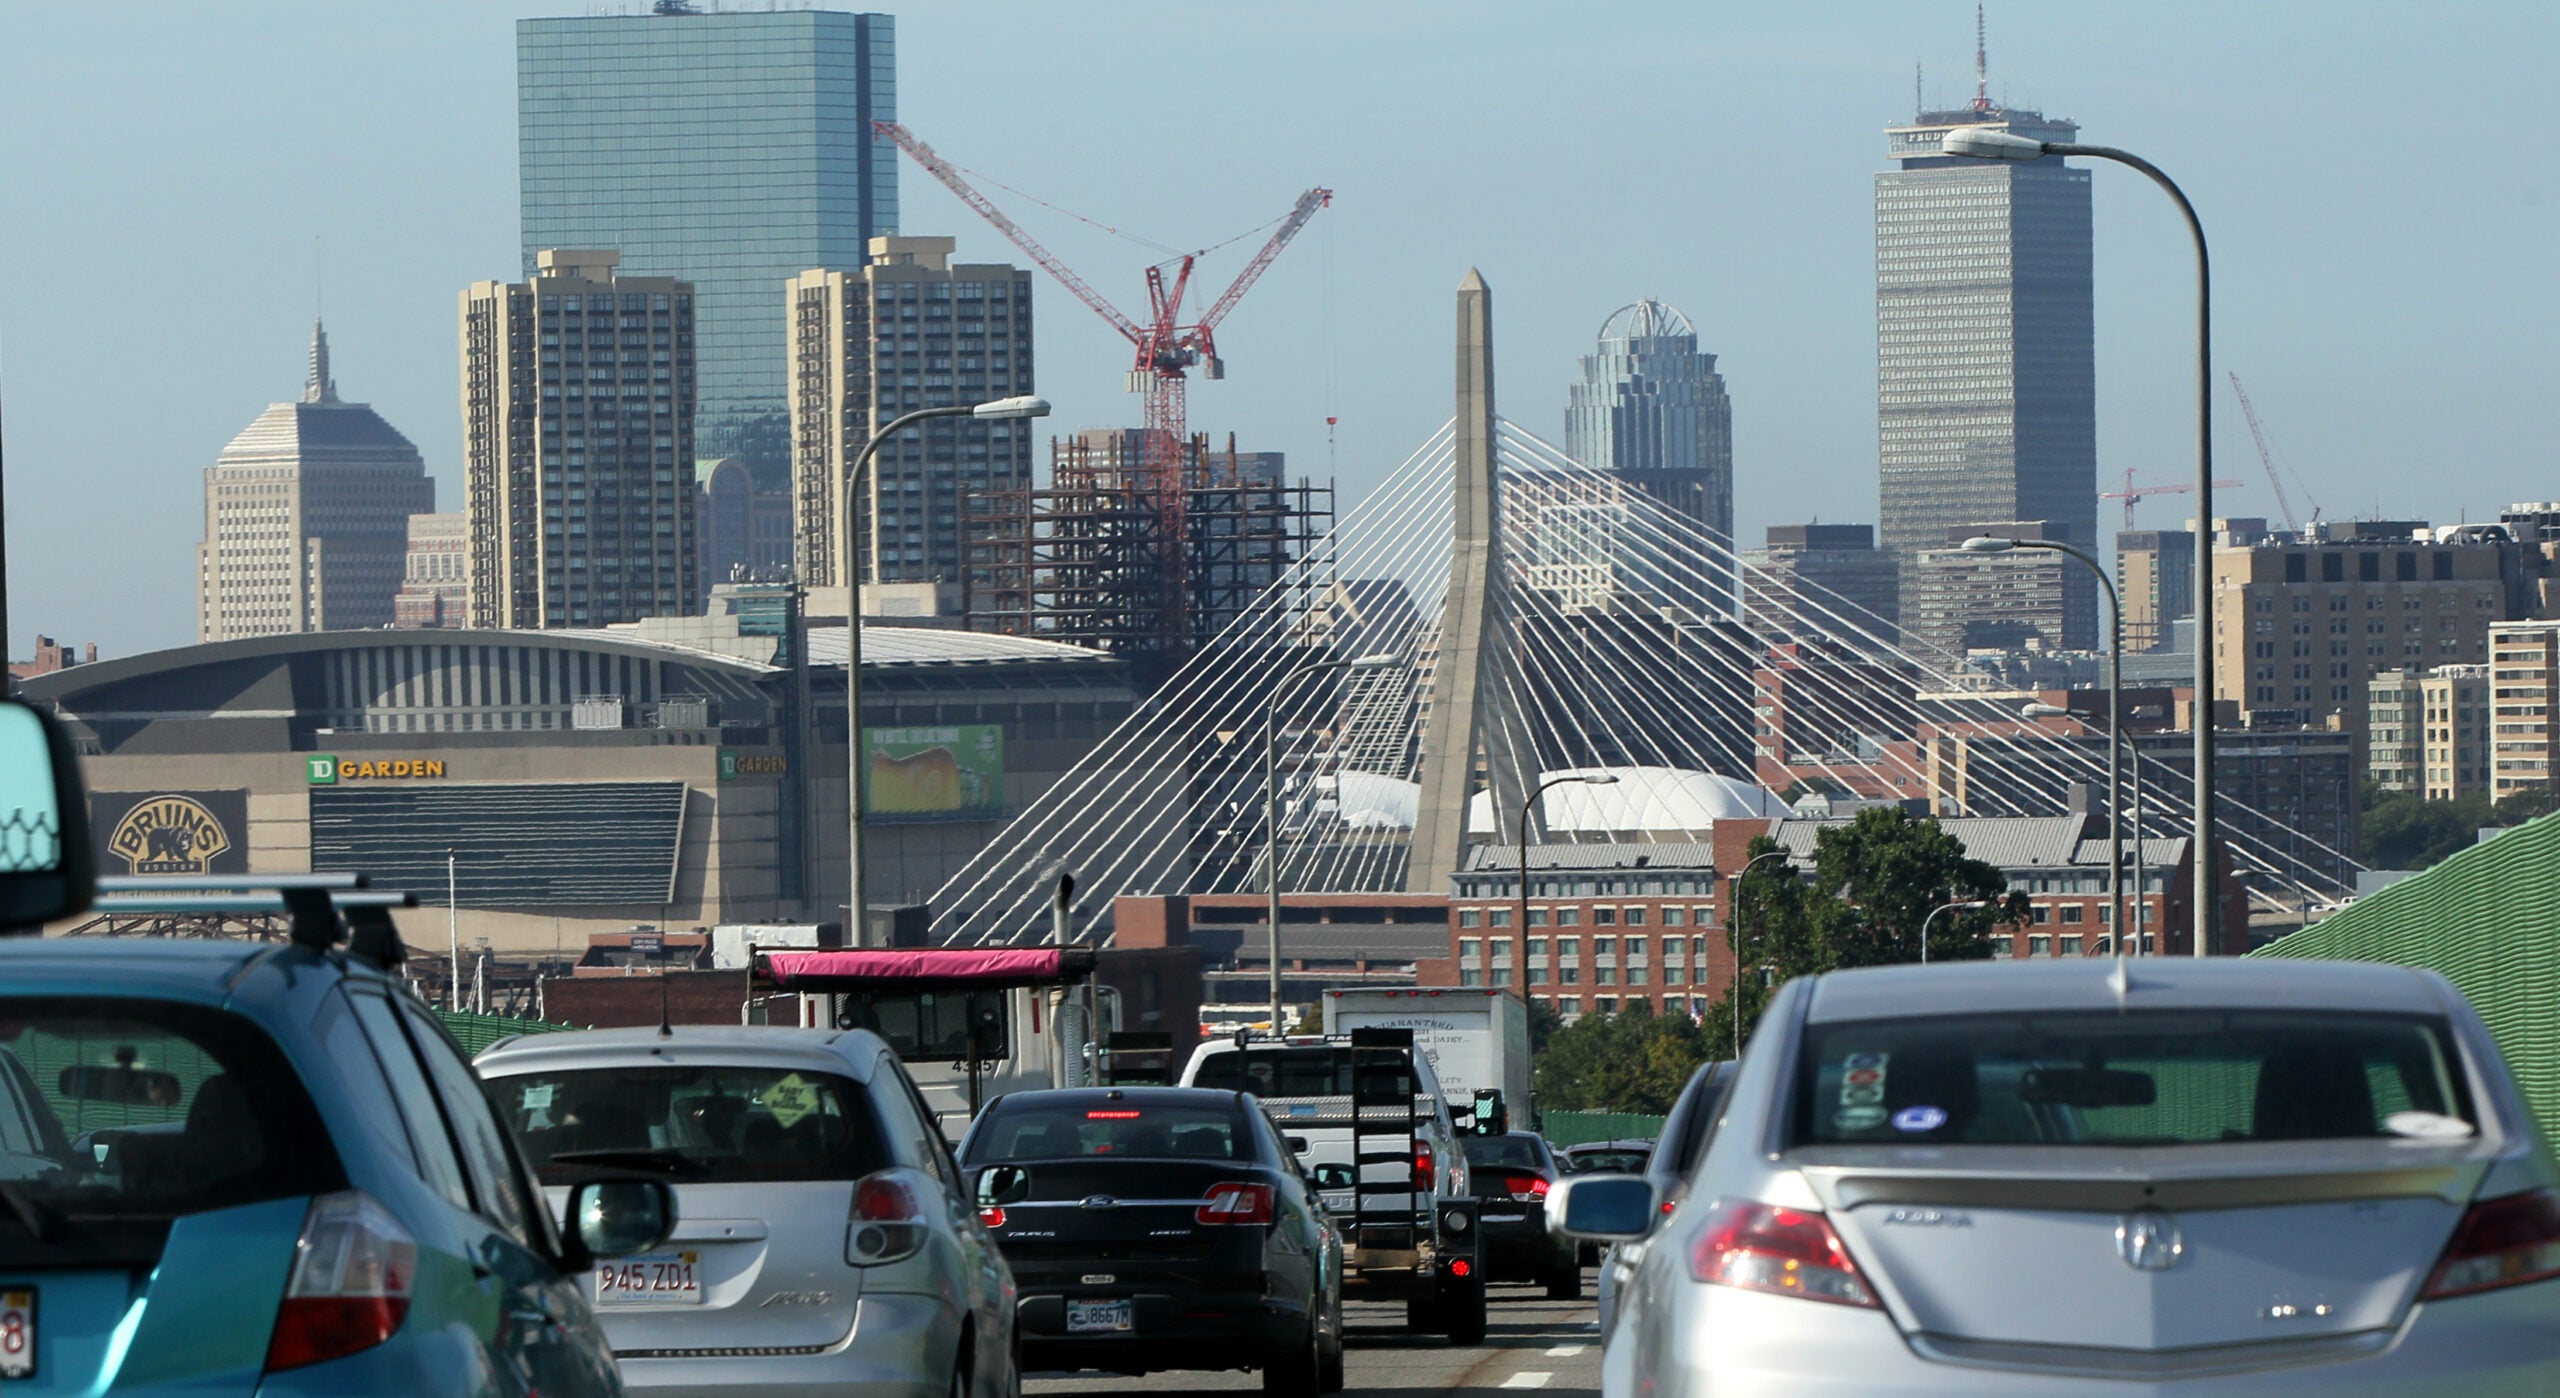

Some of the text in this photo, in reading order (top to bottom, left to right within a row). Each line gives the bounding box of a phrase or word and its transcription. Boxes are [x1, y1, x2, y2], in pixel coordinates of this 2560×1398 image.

[309, 760, 444, 778] TD GARDEN
[736, 755, 787, 773] GARDEN
[118, 804, 218, 854] BRUINS
[144, 863, 195, 872] BOSTON
[952, 1059, 992, 1072] 435
[600, 1263, 697, 1291] 945 ZD1
